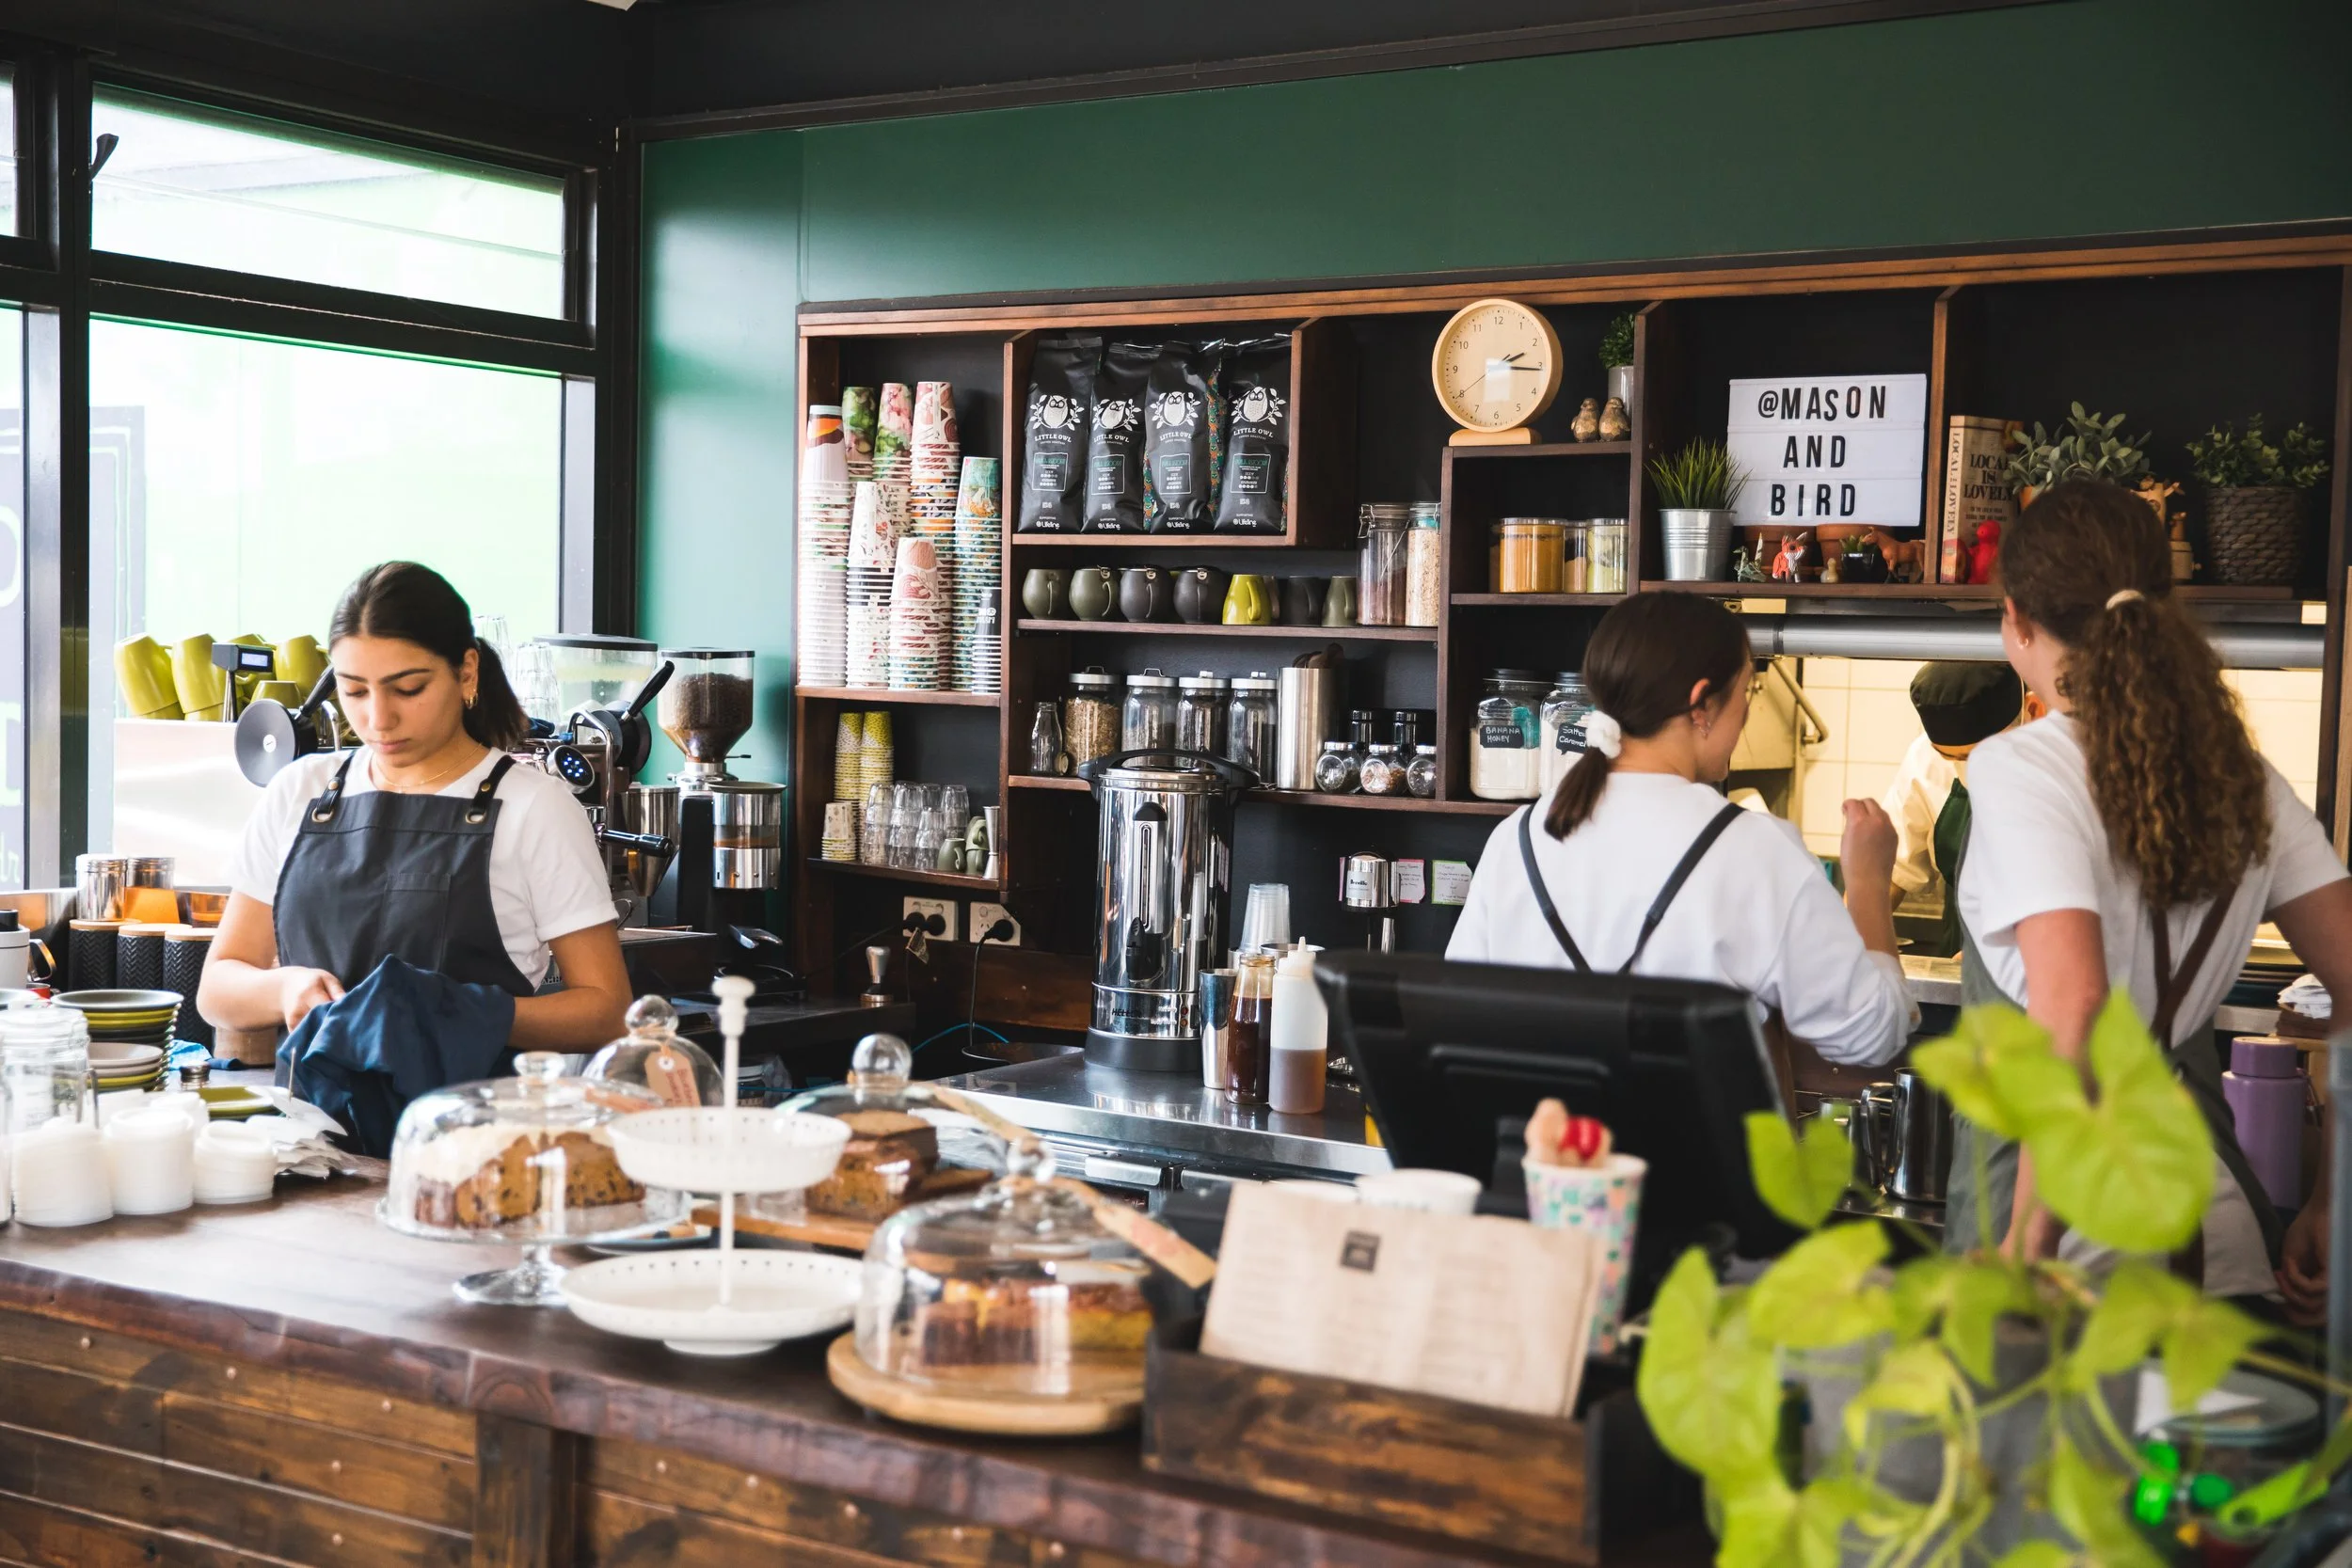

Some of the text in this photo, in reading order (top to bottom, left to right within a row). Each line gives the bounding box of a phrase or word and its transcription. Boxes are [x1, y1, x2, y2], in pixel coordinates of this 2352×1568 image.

[1494, 316, 1503, 325] 12
[1519, 322, 1523, 330] 1
[1459, 341, 1469, 349] 10
[1532, 338, 1538, 347] 2
[1453, 365, 1458, 374] 9
[1758, 385, 1886, 421] @MASON
[1474, 405, 1479, 413] 7
[1160, 432, 1179, 441] LITTLE
[1233, 428, 1273, 438] LITTLE OWL
[1058, 434, 1072, 443] OWL
[1094, 434, 1112, 443] LITTLE
[1783, 435, 1846, 468] AND
[1982, 470, 1996, 484] IS
[1771, 483, 1856, 516] BIRD
[1487, 735, 1510, 743] HONEY
